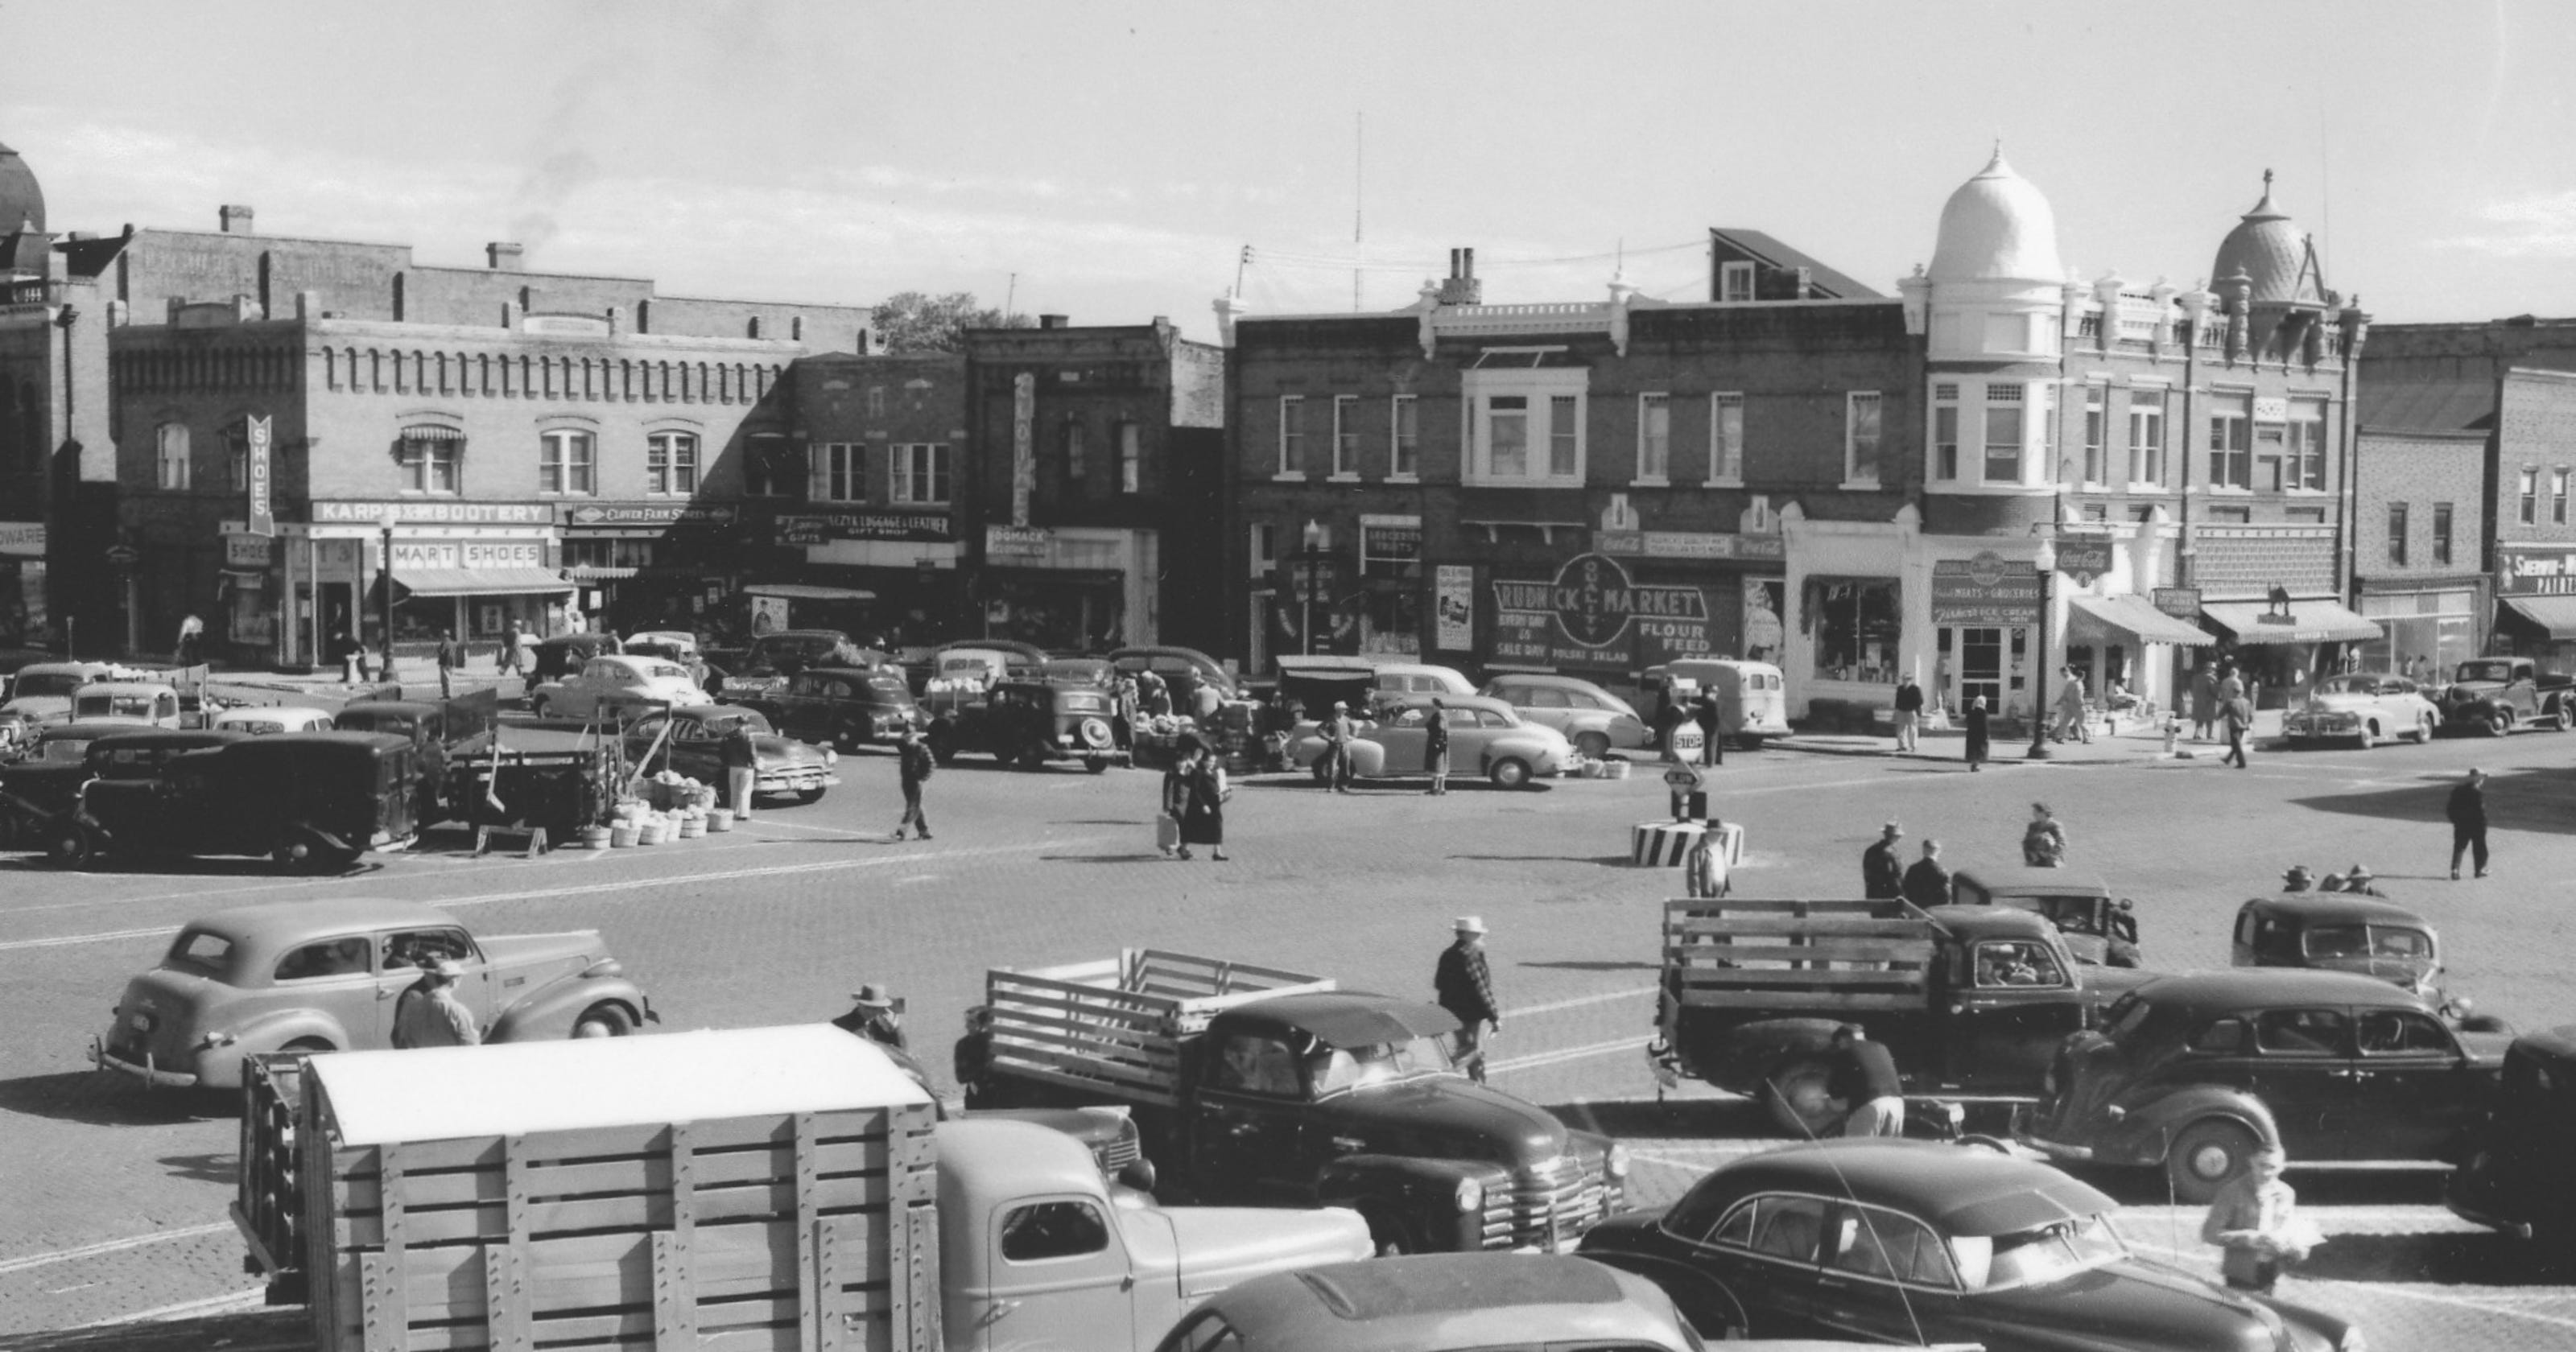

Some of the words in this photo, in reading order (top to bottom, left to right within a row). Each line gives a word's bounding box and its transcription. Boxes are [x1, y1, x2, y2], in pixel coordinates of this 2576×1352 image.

[253, 427, 266, 516] SHOES
[436, 505, 543, 520] BOOTERY
[643, 509, 670, 521] FARM
[909, 516, 949, 534] LEATHER
[469, 546, 538, 561] SHOES
[1584, 562, 1598, 637] QUALITY
[1604, 589, 1698, 614] MARKET
[1640, 623, 1705, 637] FLOUR
[1663, 638, 1711, 652] FEED
[1675, 734, 1703, 749] STOP
